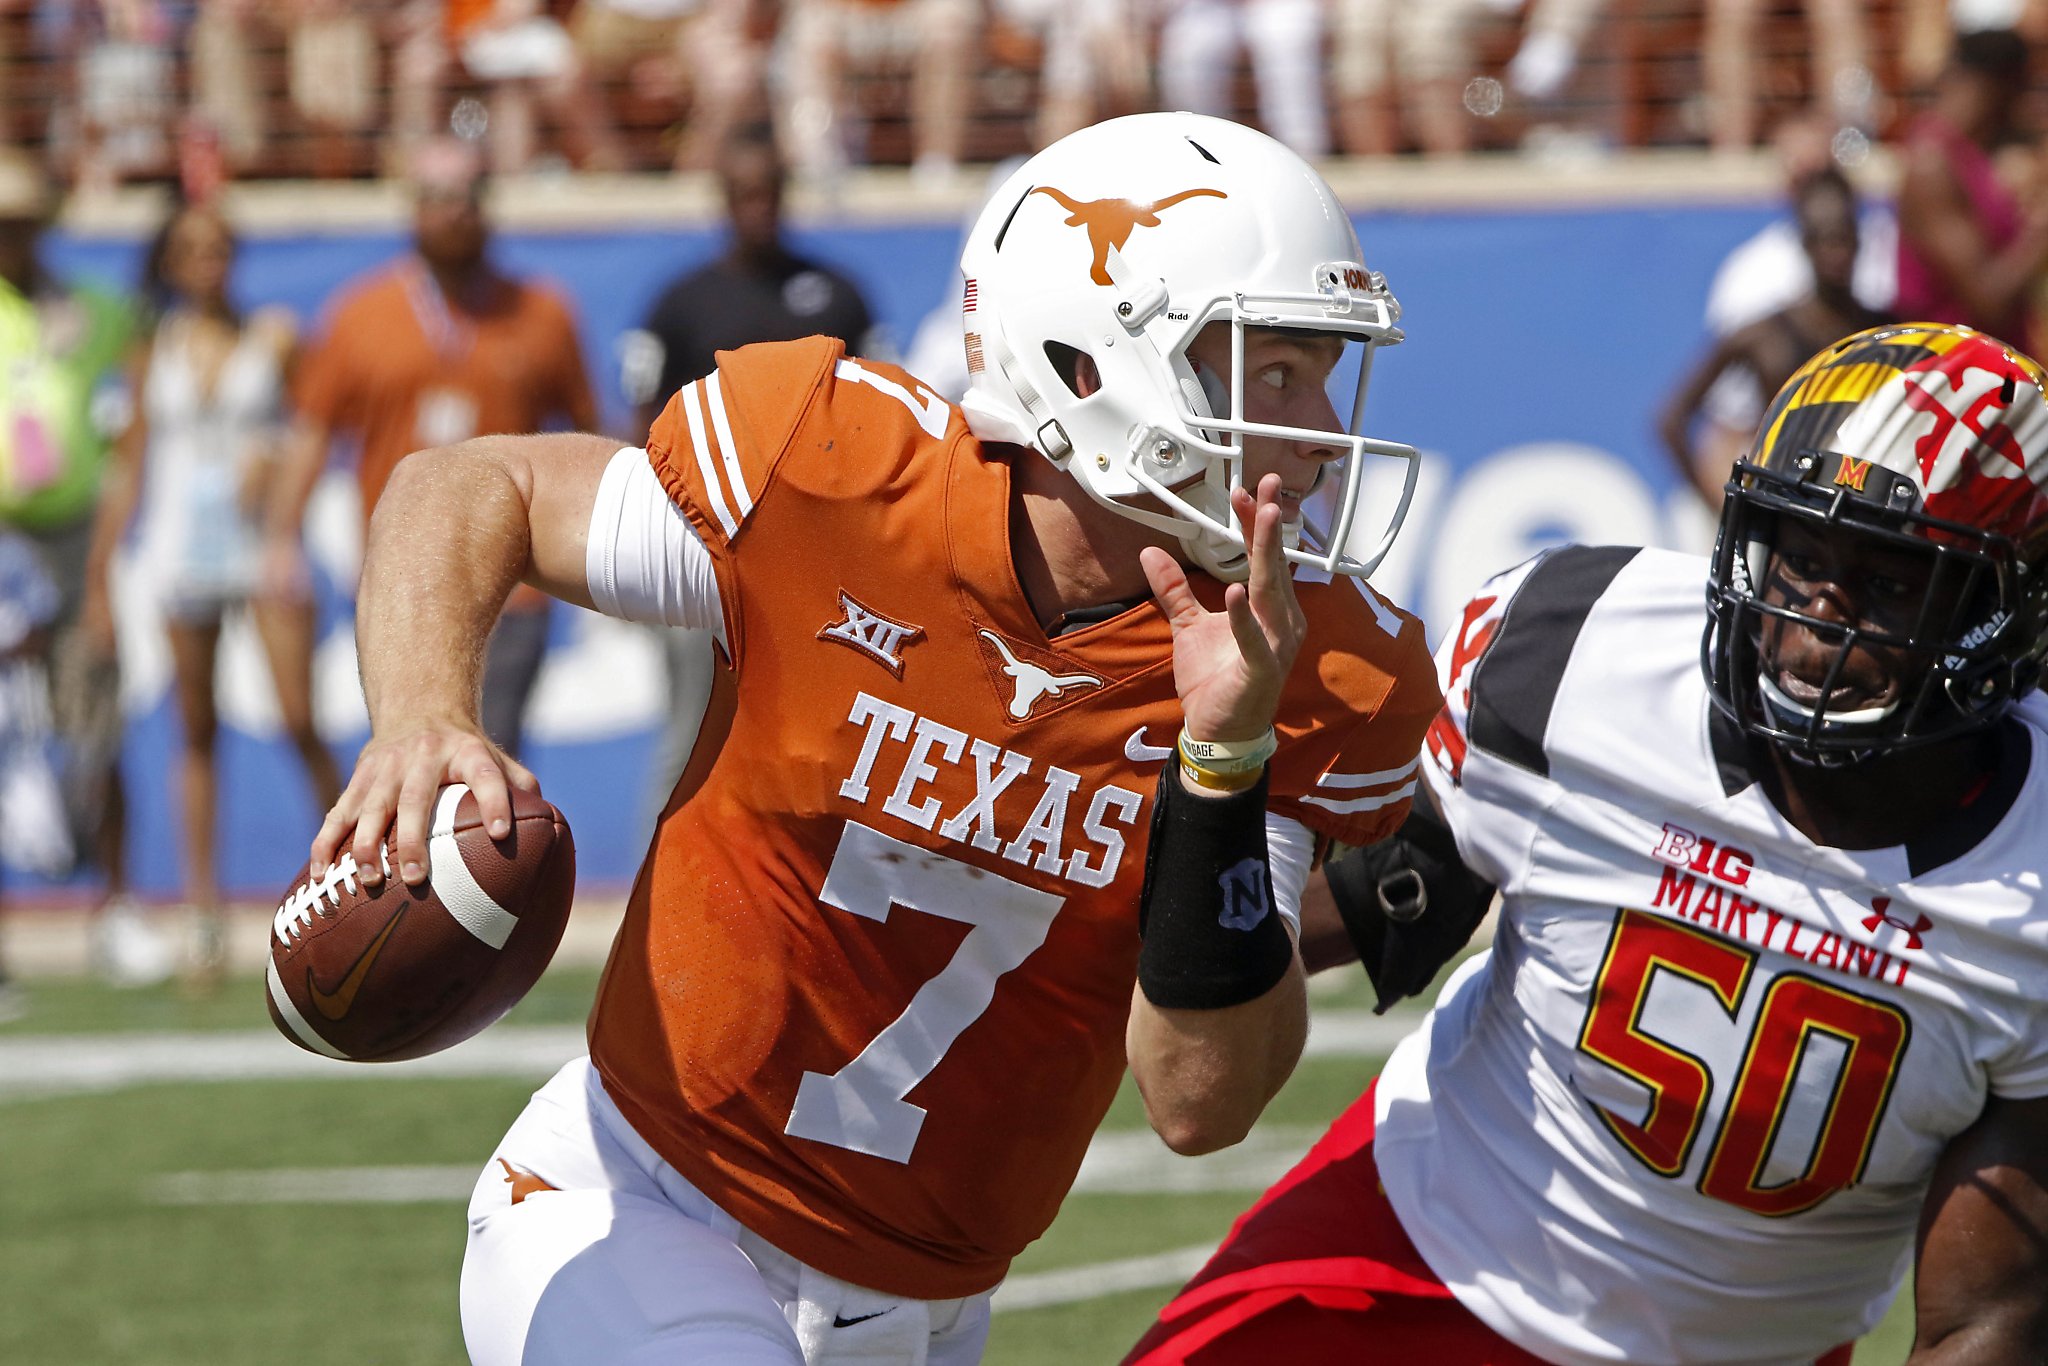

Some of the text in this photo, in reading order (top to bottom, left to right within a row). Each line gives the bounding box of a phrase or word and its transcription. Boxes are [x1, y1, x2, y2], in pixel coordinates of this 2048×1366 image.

[835, 358, 950, 440] 7
[1833, 454, 1873, 491] M
[825, 594, 917, 669] XII
[838, 690, 1144, 889] TEXAS
[783, 818, 1067, 1165] 7
[1572, 906, 1913, 1218] 50
